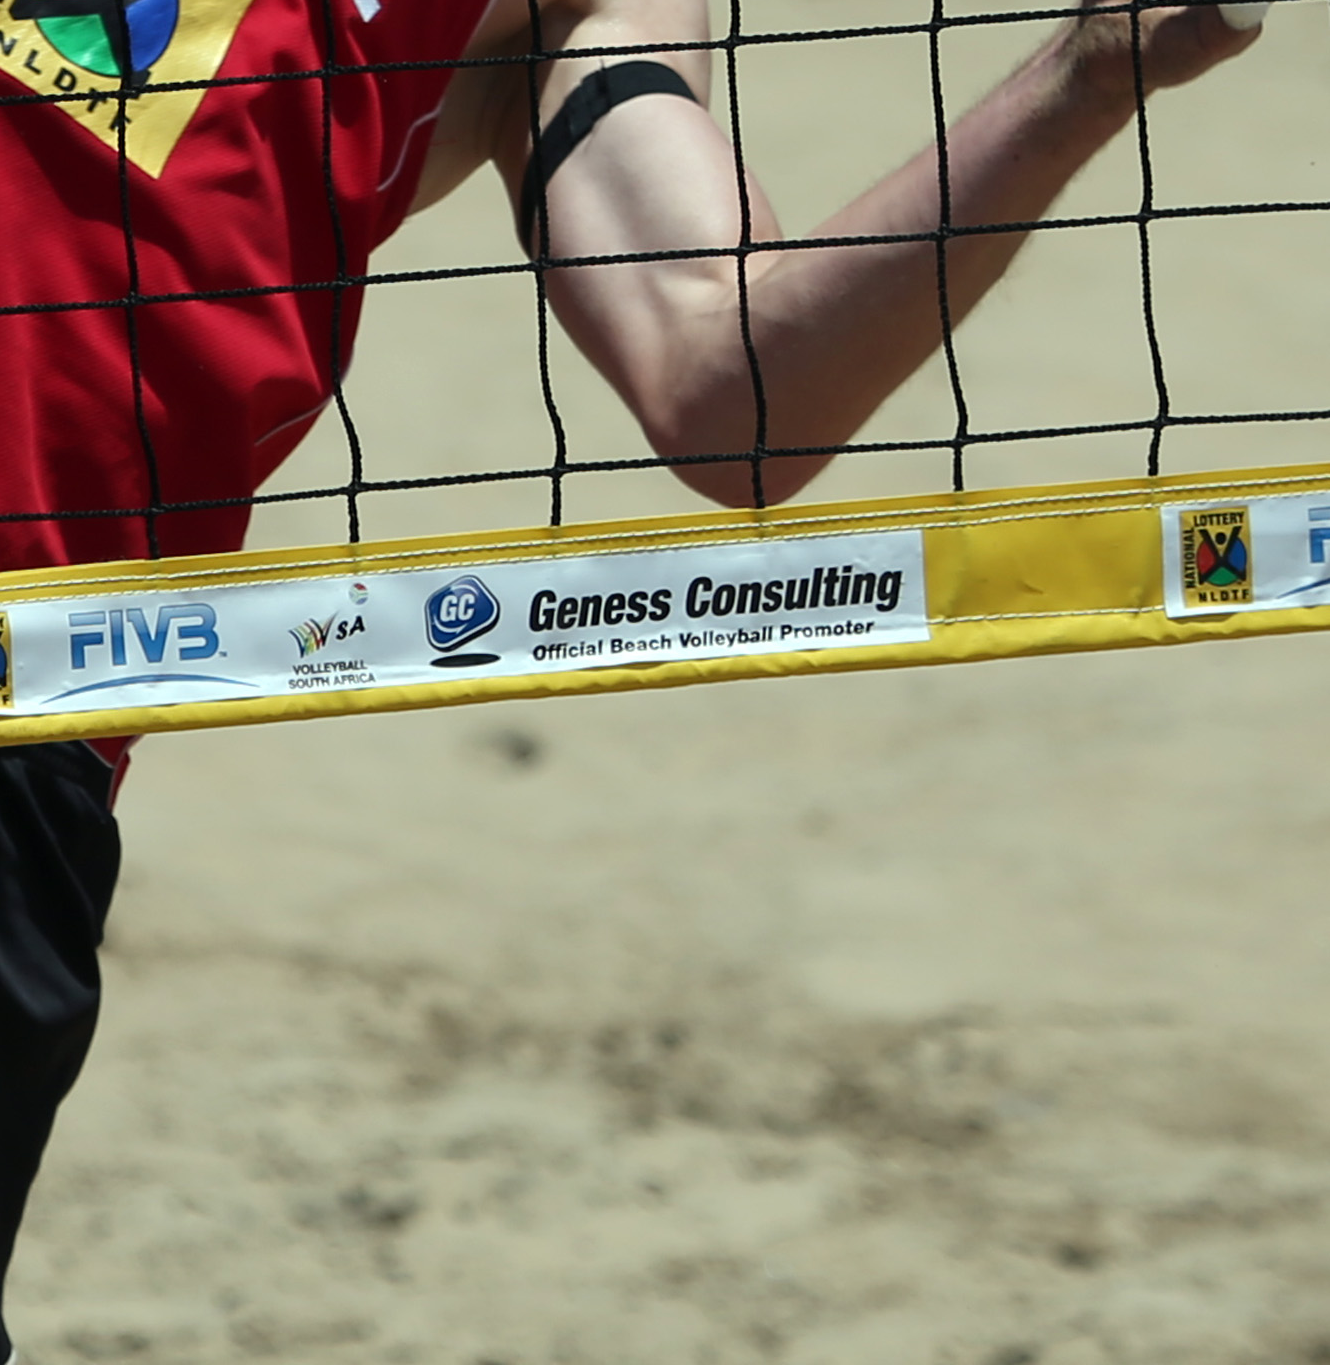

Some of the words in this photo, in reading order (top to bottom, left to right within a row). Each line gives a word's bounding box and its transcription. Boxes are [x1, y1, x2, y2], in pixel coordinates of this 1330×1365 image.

[1193, 512, 1245, 528] LOTTERY
[1183, 527, 1195, 589] NATIONAL
[439, 593, 475, 622] GC
[529, 589, 672, 634] Geness
[686, 565, 903, 619] Consulting
[1199, 589, 1250, 603] NLDTF
[68, 602, 220, 669] FIVB
[532, 639, 604, 661] Official
[610, 632, 672, 654] Beach
[678, 626, 774, 650] Volleyball
[779, 619, 875, 641] Promoter
[288, 676, 330, 689] SOUTH
[333, 672, 376, 686] AFRICA
[292, 659, 368, 675] VOLLEYBALL
